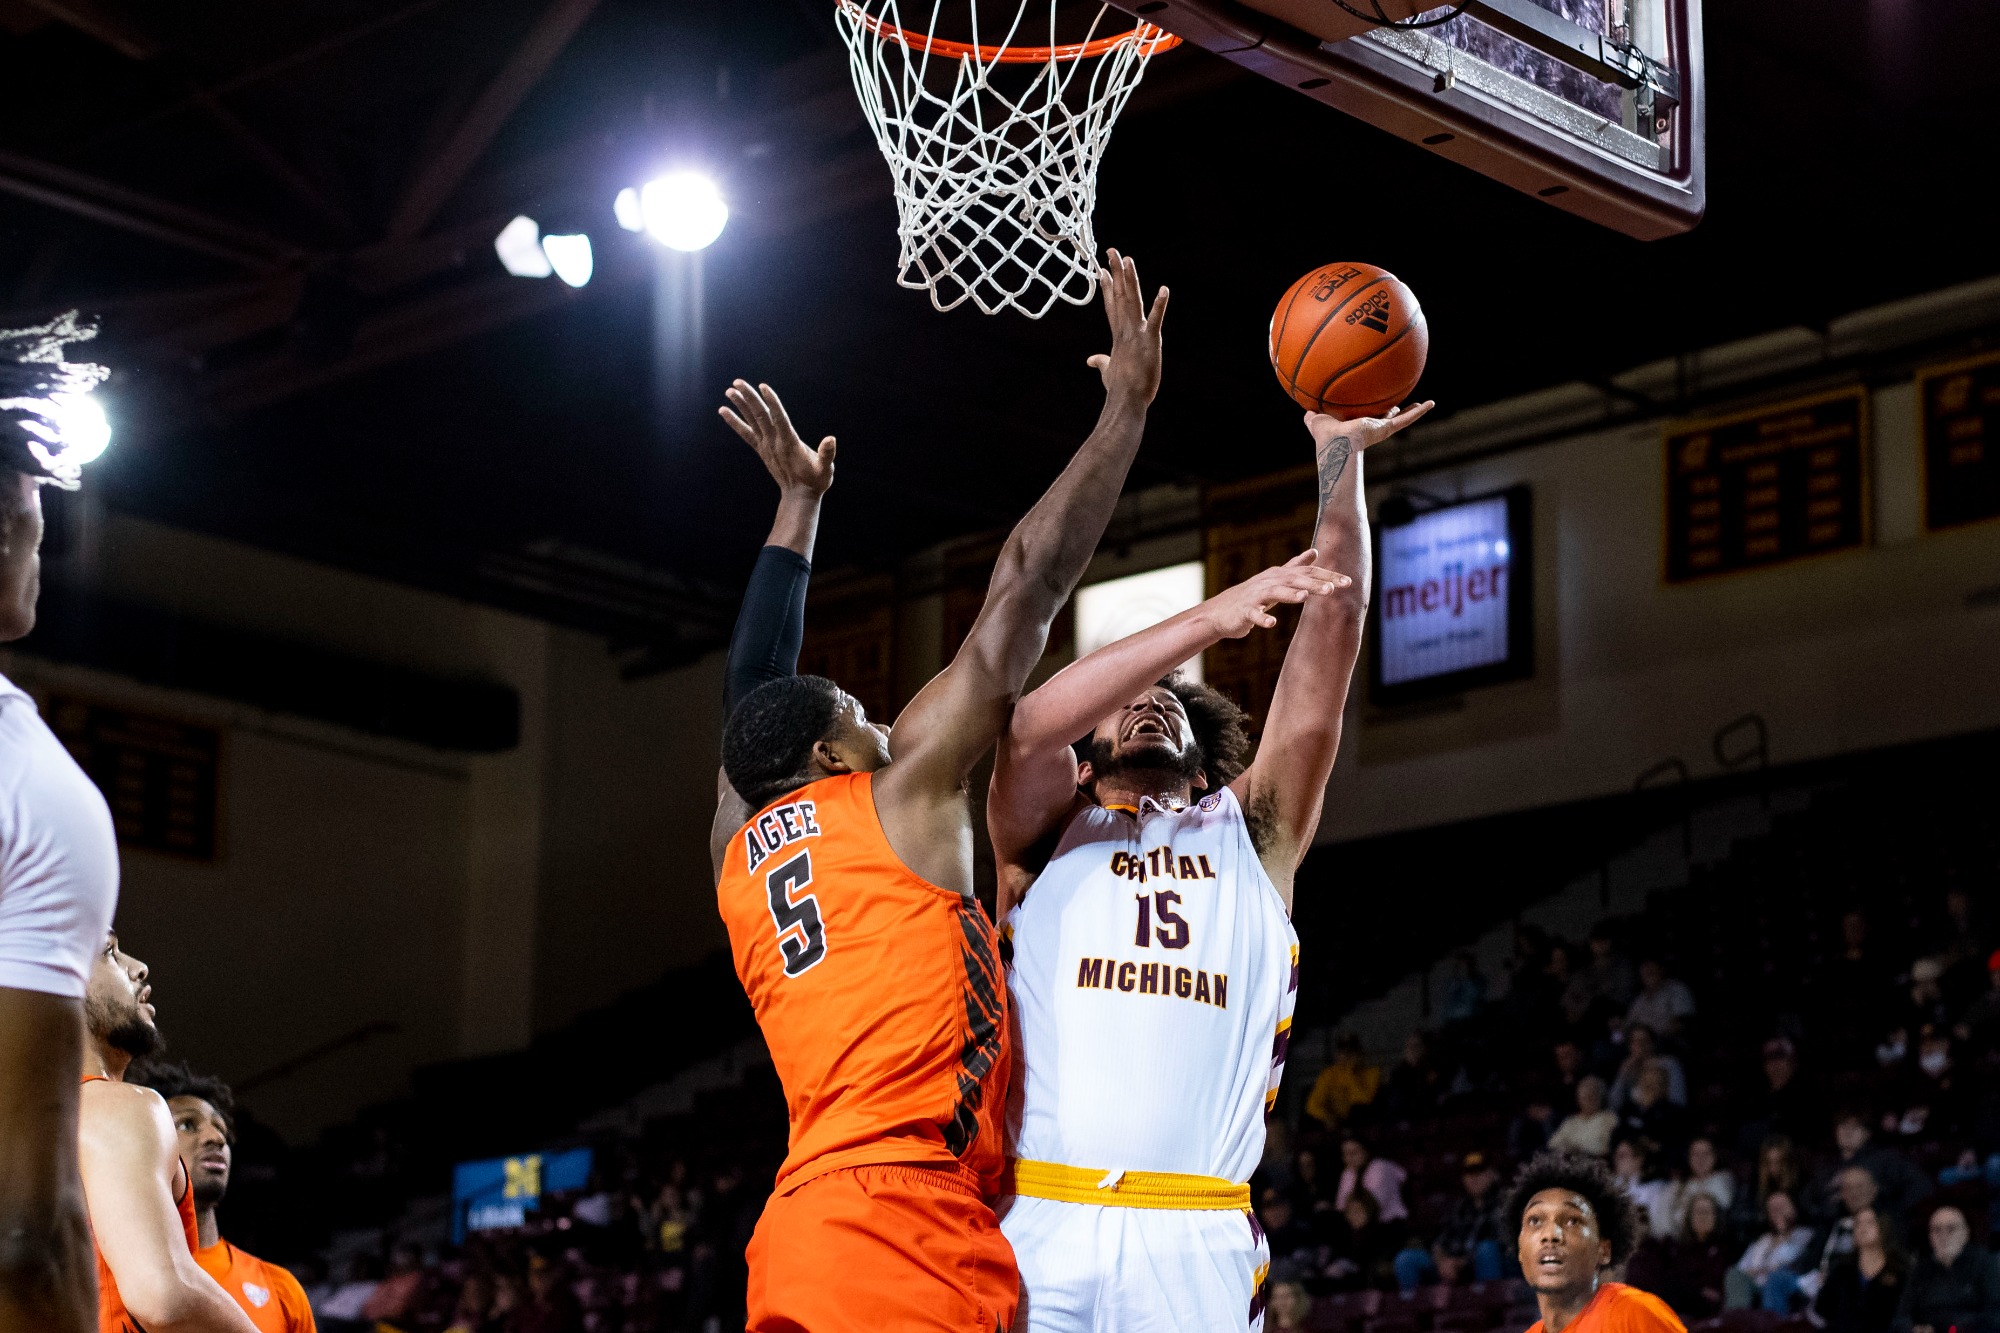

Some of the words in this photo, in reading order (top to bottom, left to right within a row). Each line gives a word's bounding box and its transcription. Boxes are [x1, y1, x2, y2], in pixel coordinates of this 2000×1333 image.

[1314, 267, 1362, 302] PRO
[1345, 289, 1388, 325] adidas
[1384, 561, 1505, 619] meijer
[745, 800, 821, 876] AGEE
[766, 847, 827, 978] 5
[1134, 889, 1190, 950] 15
[1076, 957, 1228, 1010] MICHIGAN
